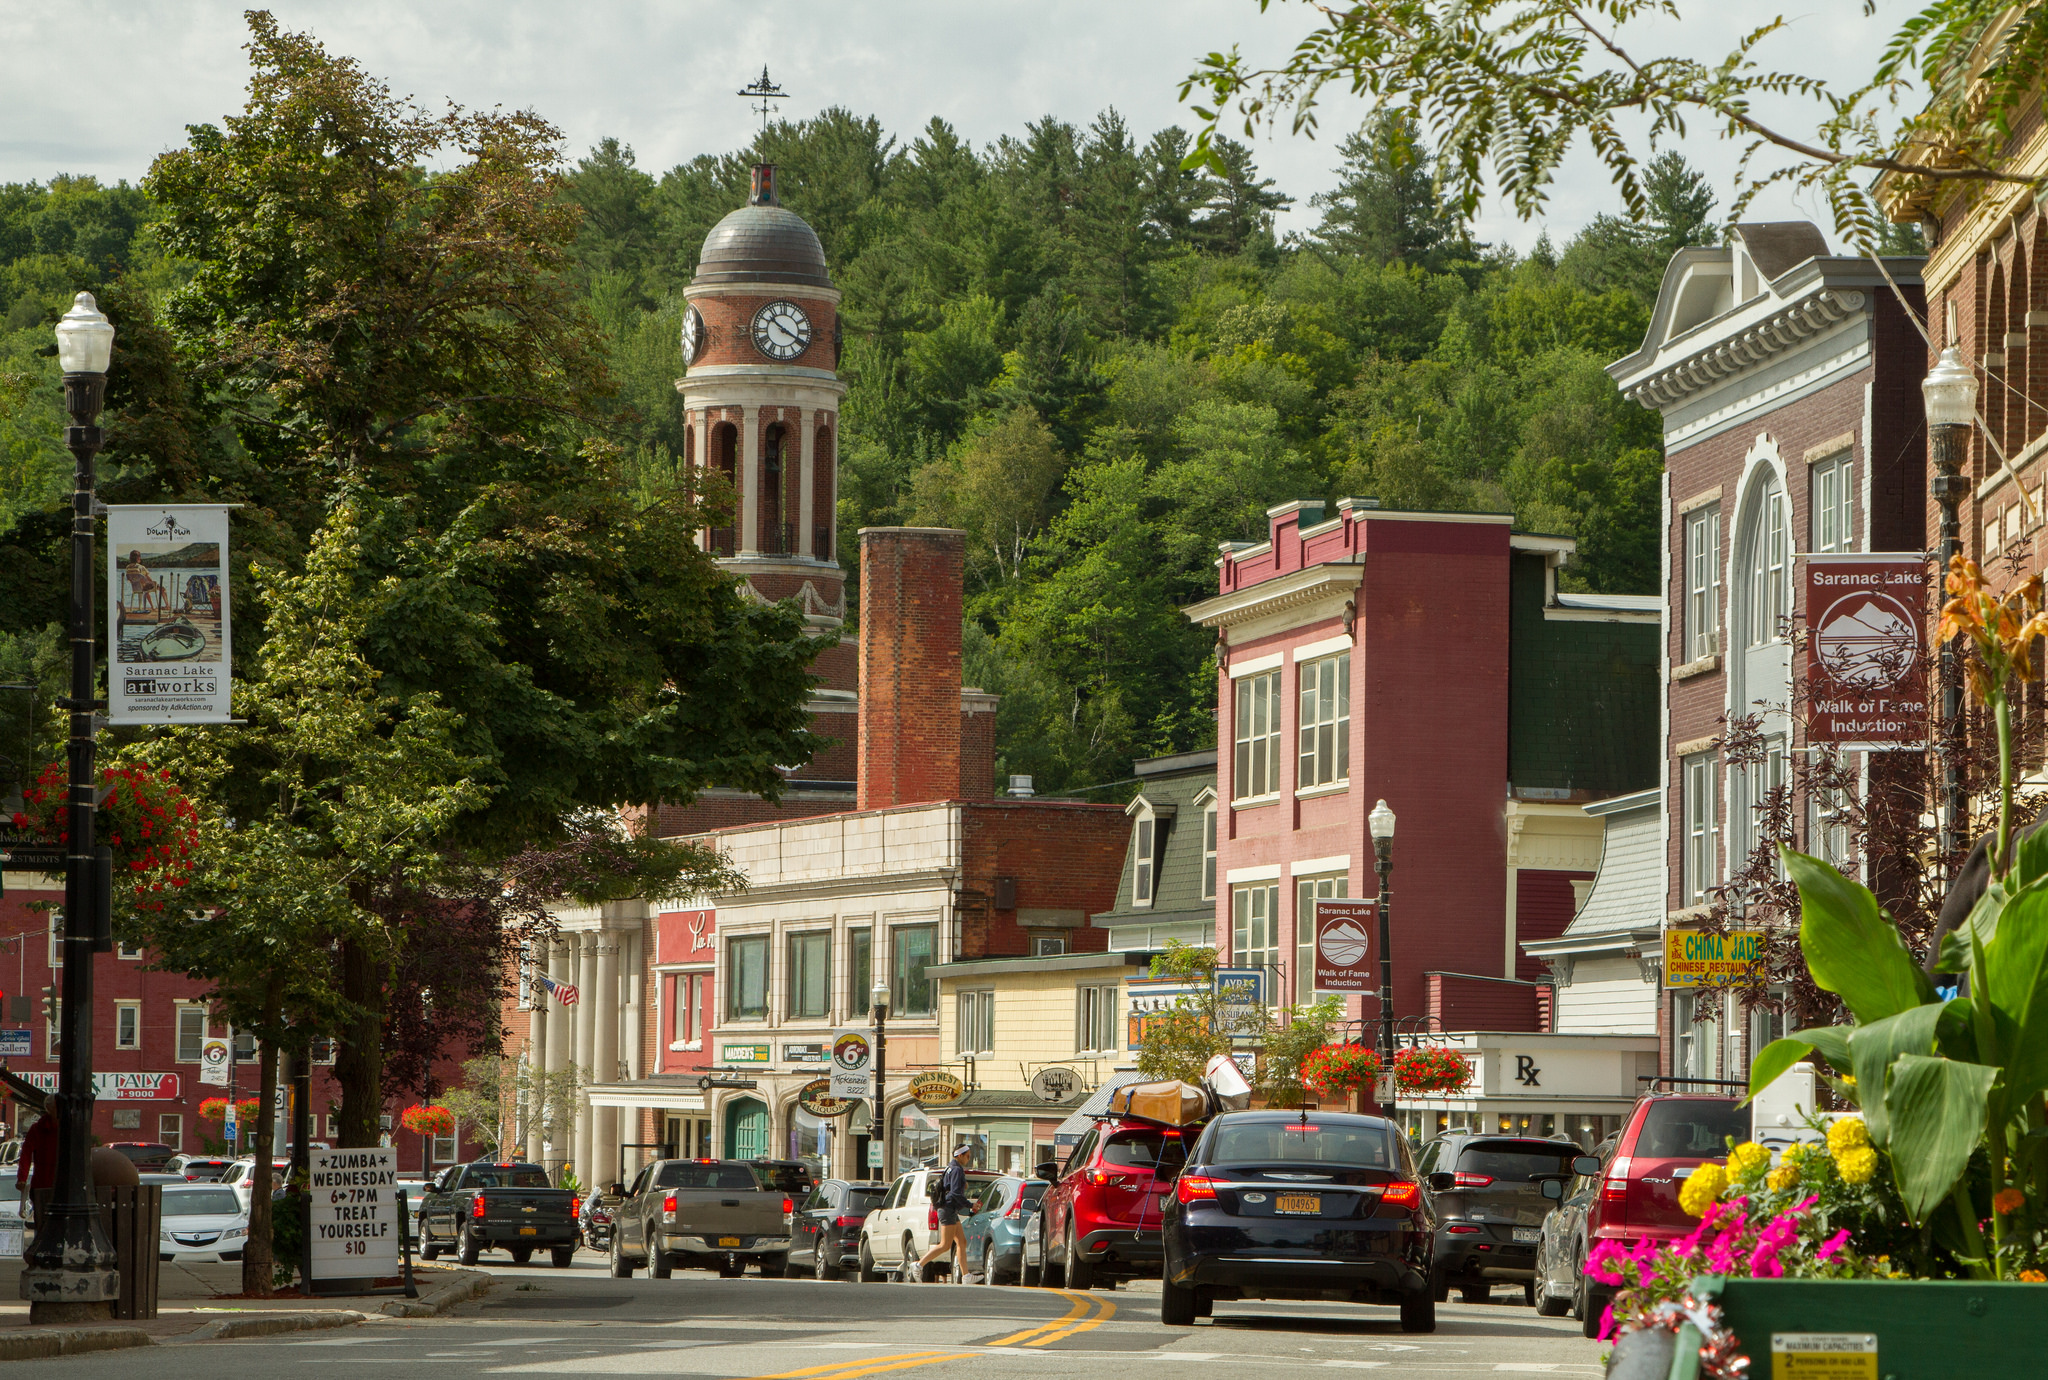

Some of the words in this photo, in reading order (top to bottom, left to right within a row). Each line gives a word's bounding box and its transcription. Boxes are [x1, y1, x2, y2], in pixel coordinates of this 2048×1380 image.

[1813, 571, 1879, 586] Saranac
[1885, 571, 1922, 585] Lake
[126, 666, 178, 676] Saranac
[183, 665, 214, 675] Lake
[127, 679, 215, 693] artworks
[161, 704, 169, 712] by
[170, 703, 213, 712] AdkAction.org
[1815, 699, 1854, 714] Walk
[1858, 699, 1875, 713] of
[1831, 719, 1907, 733] Induction
[1319, 907, 1351, 915] Saranac
[1352, 908, 1371, 916] Lake
[1685, 935, 1724, 960] CHINA
[1318, 969, 1337, 977] Walk
[1338, 969, 1347, 977] of
[1348, 969, 1370, 978] Fame
[1670, 961, 1705, 973] CHINESE
[1325, 978, 1362, 987] Induction
[102, 1073, 164, 1088] ITALY
[806, 1080, 831, 1092] SARANA
[937, 1072, 959, 1086] NEST
[918, 1084, 953, 1095] PIZZERIA
[811, 1102, 846, 1113] LIQUOR
[330, 1154, 377, 1169] ZUMBA
[313, 1171, 395, 1187] WEDNESDAY
[349, 1188, 378, 1203] 7PM
[1281, 1197, 1315, 1210] 7104965
[335, 1206, 377, 1221] TREAT
[319, 1222, 388, 1238] YOURSELF
[345, 1241, 366, 1255] $10
[1786, 1342, 1820, 1350] MAXIMUM
[1822, 1342, 1864, 1351] CAPACITIES
[1785, 1353, 1794, 1368] 2
